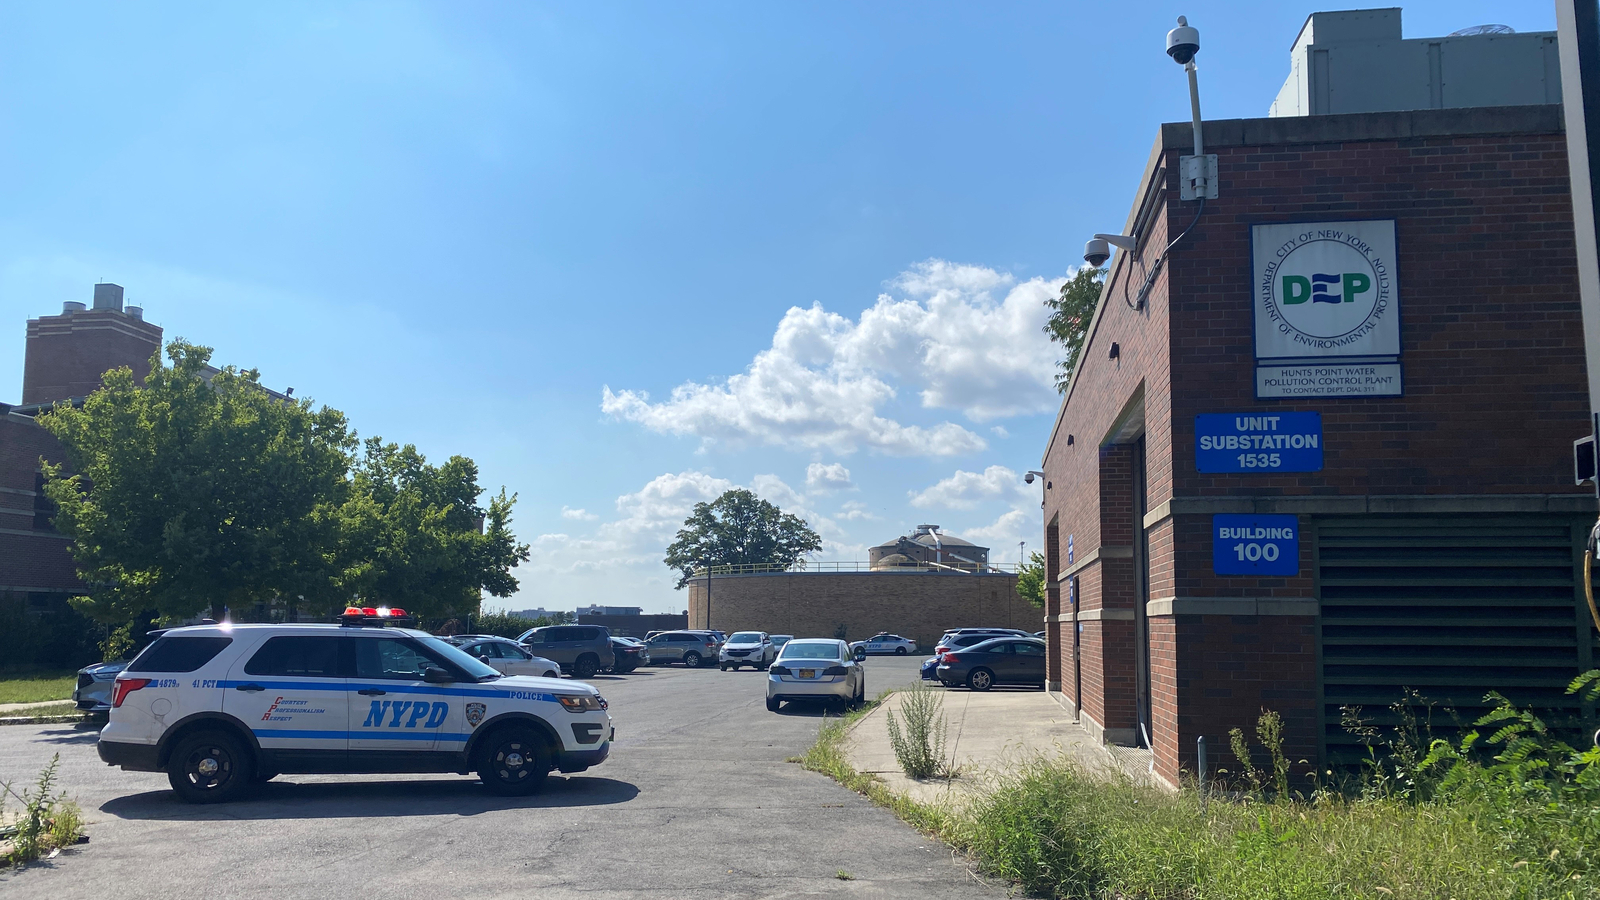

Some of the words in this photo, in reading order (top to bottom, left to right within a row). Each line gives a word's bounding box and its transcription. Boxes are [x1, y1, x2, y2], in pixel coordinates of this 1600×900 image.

[1276, 238, 1297, 258] CITY
[1299, 231, 1314, 242] OF
[1317, 229, 1344, 239] NEW
[1345, 234, 1373, 256] YORK
[1282, 272, 1371, 305] DEP
[1262, 261, 1280, 322] DEPARTMENT
[1278, 323, 1293, 336] OF
[1293, 321, 1377, 349] ENVIRONMENTAL
[1372, 258, 1390, 320] PROTECTION
[1281, 368, 1313, 377] HUNTS
[1315, 368, 1342, 376] POINT
[1345, 367, 1376, 375] WATER
[1264, 378, 1316, 386] POLLUTION
[1318, 377, 1362, 385] CONTROL
[1365, 376, 1393, 384] PLANT
[1235, 416, 1281, 432] UNIT
[1199, 434, 1319, 450] SUBSTATION
[1237, 453, 1282, 468] 1535
[1219, 527, 1294, 540] BUILDING
[1233, 542, 1280, 562] 100
[158, 679, 177, 688] 4879
[192, 679, 200, 688] 41
[202, 679, 217, 688] PCT
[510, 690, 542, 701] POLICE
[362, 700, 449, 729] NYPD
